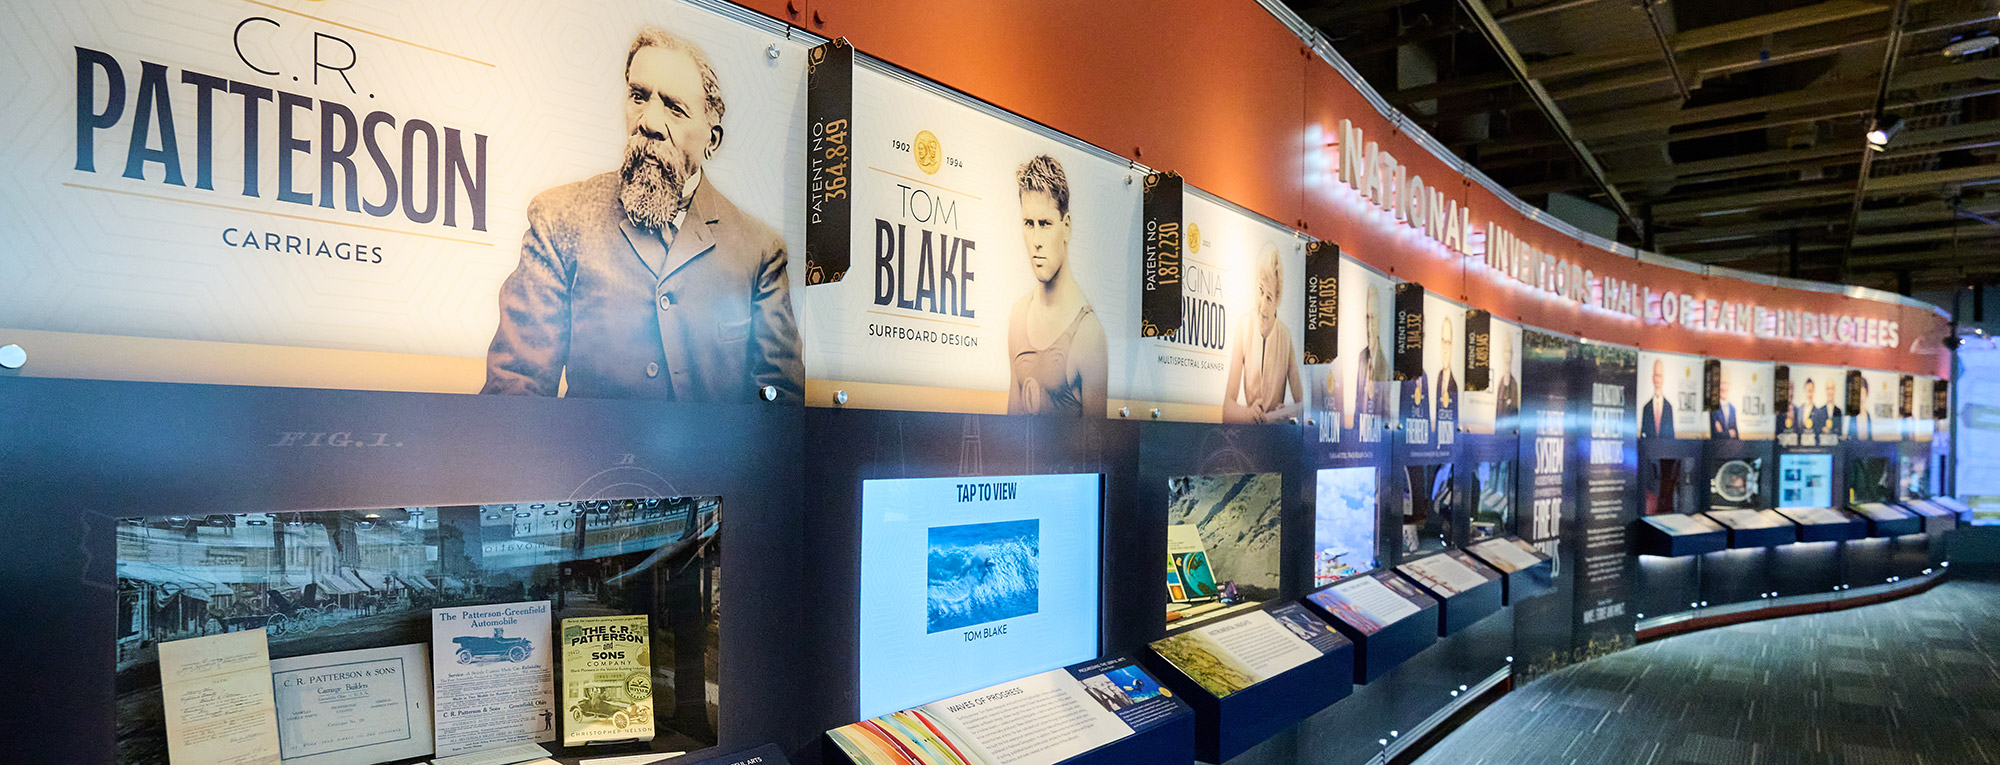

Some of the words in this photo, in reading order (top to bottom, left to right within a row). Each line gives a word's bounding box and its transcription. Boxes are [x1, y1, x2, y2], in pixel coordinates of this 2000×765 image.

[233, 17, 375, 98] C.R.
[74, 46, 488, 232] PATTERSON
[812, 117, 824, 148] NO.
[892, 140, 910, 152] 1902
[825, 118, 848, 202] 364,849
[946, 157, 963, 168] 1994
[812, 154, 823, 224] PATENT
[897, 184, 958, 230] TOM
[1147, 217, 1157, 240] NO.
[1339, 119, 1474, 256] NATIONAL
[1485, 220, 1593, 304] INVENTORS
[1602, 276, 1650, 318] HALL
[1661, 290, 1693, 325] OF
[1704, 299, 1766, 335] FAME
[1776, 308, 1899, 348] INDUCTEES
[222, 228, 383, 264] CARRIAGES
[1158, 222, 1180, 285] 1,872,230
[874, 218, 976, 319] BLAKE
[1147, 245, 1156, 291] PATENT
[1182, 264, 1223, 298] RGINIA
[1309, 274, 1318, 293] NO.
[1309, 295, 1317, 330] PATENT
[1318, 277, 1337, 327] 2,746,035
[868, 323, 938, 343] SURFBOARD
[940, 332, 978, 347] DESIGN
[1157, 296, 1226, 350] RWOOD
[1398, 325, 1406, 354] PATENT
[1158, 356, 1200, 369] MULTISPECTRAL
[1200, 361, 1224, 371] SCANNER
[956, 483, 976, 503] TAP
[978, 483, 992, 501] TO
[993, 482, 1018, 501] VIEW
[440, 613, 457, 621] The
[462, 605, 546, 619] Patterson-Greenfield
[471, 618, 518, 628] Automobile
[572, 634, 644, 646] PATTERSON
[582, 626, 606, 635] THE
[609, 625, 633, 634] C.R.
[963, 630, 982, 643] TOM
[983, 624, 1008, 640] BLAKE
[592, 651, 625, 660] SONS
[603, 642, 613, 650] and
[283, 680, 293, 688] C.
[296, 678, 306, 686] R.
[309, 671, 363, 684] PATTERSON
[374, 667, 396, 676] SONS
[947, 701, 976, 714] WAVES
[974, 696, 986, 706] OF
[987, 687, 1024, 702] PROGRESS
[571, 729, 621, 737] CHRISTOPHER
